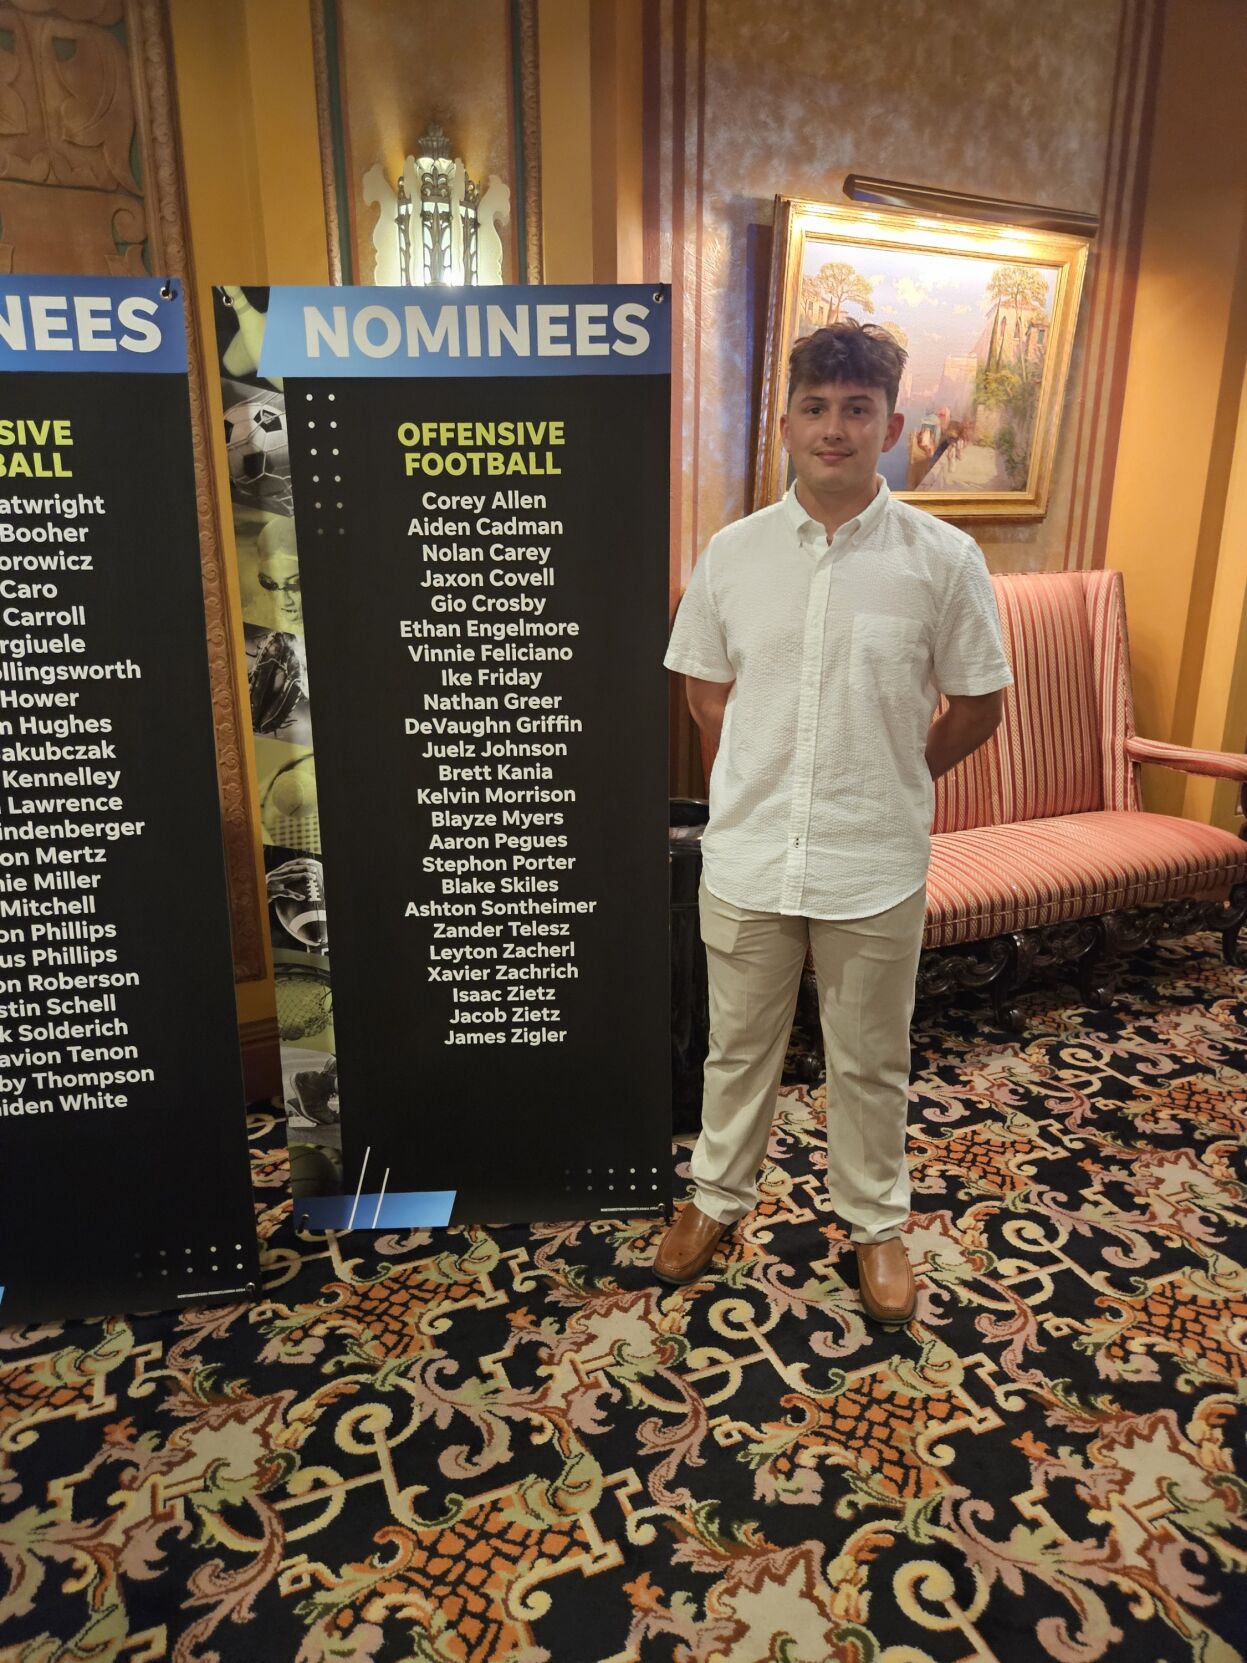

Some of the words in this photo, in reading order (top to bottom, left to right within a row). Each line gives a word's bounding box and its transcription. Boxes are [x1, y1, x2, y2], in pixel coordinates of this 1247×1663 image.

[303, 303, 651, 358] NOMINEES
[397, 421, 566, 447] OFFENSIVE
[404, 451, 562, 477] FOOTBALL
[421, 491, 486, 514] Corey
[491, 489, 547, 510] Allen
[0, 521, 89, 543] Booher
[407, 516, 471, 536] Aiden
[475, 516, 564, 536] Cadman
[422, 542, 484, 562] Nolan
[489, 543, 552, 565] Carey
[420, 569, 484, 588] Jaxon
[489, 567, 555, 587] Covell
[0, 579, 58, 599] Caro
[430, 593, 467, 613] Gio
[471, 592, 547, 616] Crosby
[2, 605, 86, 627] Carroll
[399, 618, 461, 638] Ethan
[466, 618, 580, 641] Engelmore
[407, 643, 476, 663] Vinnie
[480, 642, 573, 662] Feliciano
[0, 658, 142, 685] llingsworth
[441, 668, 473, 687] Ike
[477, 667, 543, 690] Friday
[0, 689, 80, 709] Hower
[423, 692, 499, 711] Nathan
[503, 692, 563, 710] Greer
[19, 713, 113, 739] Hughes
[404, 715, 511, 738] DeVaughn
[516, 714, 583, 734] Griffin
[0, 739, 117, 762] akubczak
[421, 740, 476, 759] Juelz
[480, 739, 568, 758] Johnson
[2, 766, 121, 790] Kennelley
[438, 764, 493, 781] Brett
[497, 762, 553, 781] Kania
[7, 796, 123, 815] Lawrence
[417, 786, 480, 805] Kelvin
[485, 785, 576, 804] Morrison
[431, 810, 497, 831] Blayze
[502, 809, 564, 830] Myers
[428, 833, 490, 850] Aaron
[494, 832, 568, 852] Pegues
[35, 846, 107, 865] Mertz
[422, 855, 508, 876] Stephon
[512, 855, 577, 871] Porter
[33, 870, 102, 891] Miller
[441, 877, 496, 895] Blake
[500, 876, 559, 894] Skiles
[0, 894, 96, 918] Mitchell
[404, 900, 477, 917] Ashton
[481, 897, 598, 916] Sontheimer
[30, 920, 117, 943] Phillips
[433, 921, 504, 939] Zander
[507, 920, 571, 937] Telesz
[31, 945, 118, 968] Phillips
[429, 945, 498, 964] Leyton
[502, 941, 575, 959] Zacherl
[27, 971, 140, 992] Roberson
[427, 964, 491, 982] Xavier
[495, 962, 579, 980] Zachrich
[46, 993, 117, 1016] Schell
[452, 987, 503, 1003] Isaac
[506, 984, 556, 1001] Zietz
[449, 1006, 508, 1024] Jacob
[511, 1006, 561, 1023] Zietz
[18, 1017, 129, 1042] Solderich
[444, 1030, 507, 1045] James
[510, 1026, 568, 1047] Zigler
[66, 1045, 139, 1063] Tenon
[31, 1068, 155, 1090] Thompson
[0, 1097, 54, 1117] iden
[58, 1091, 128, 1112] White
